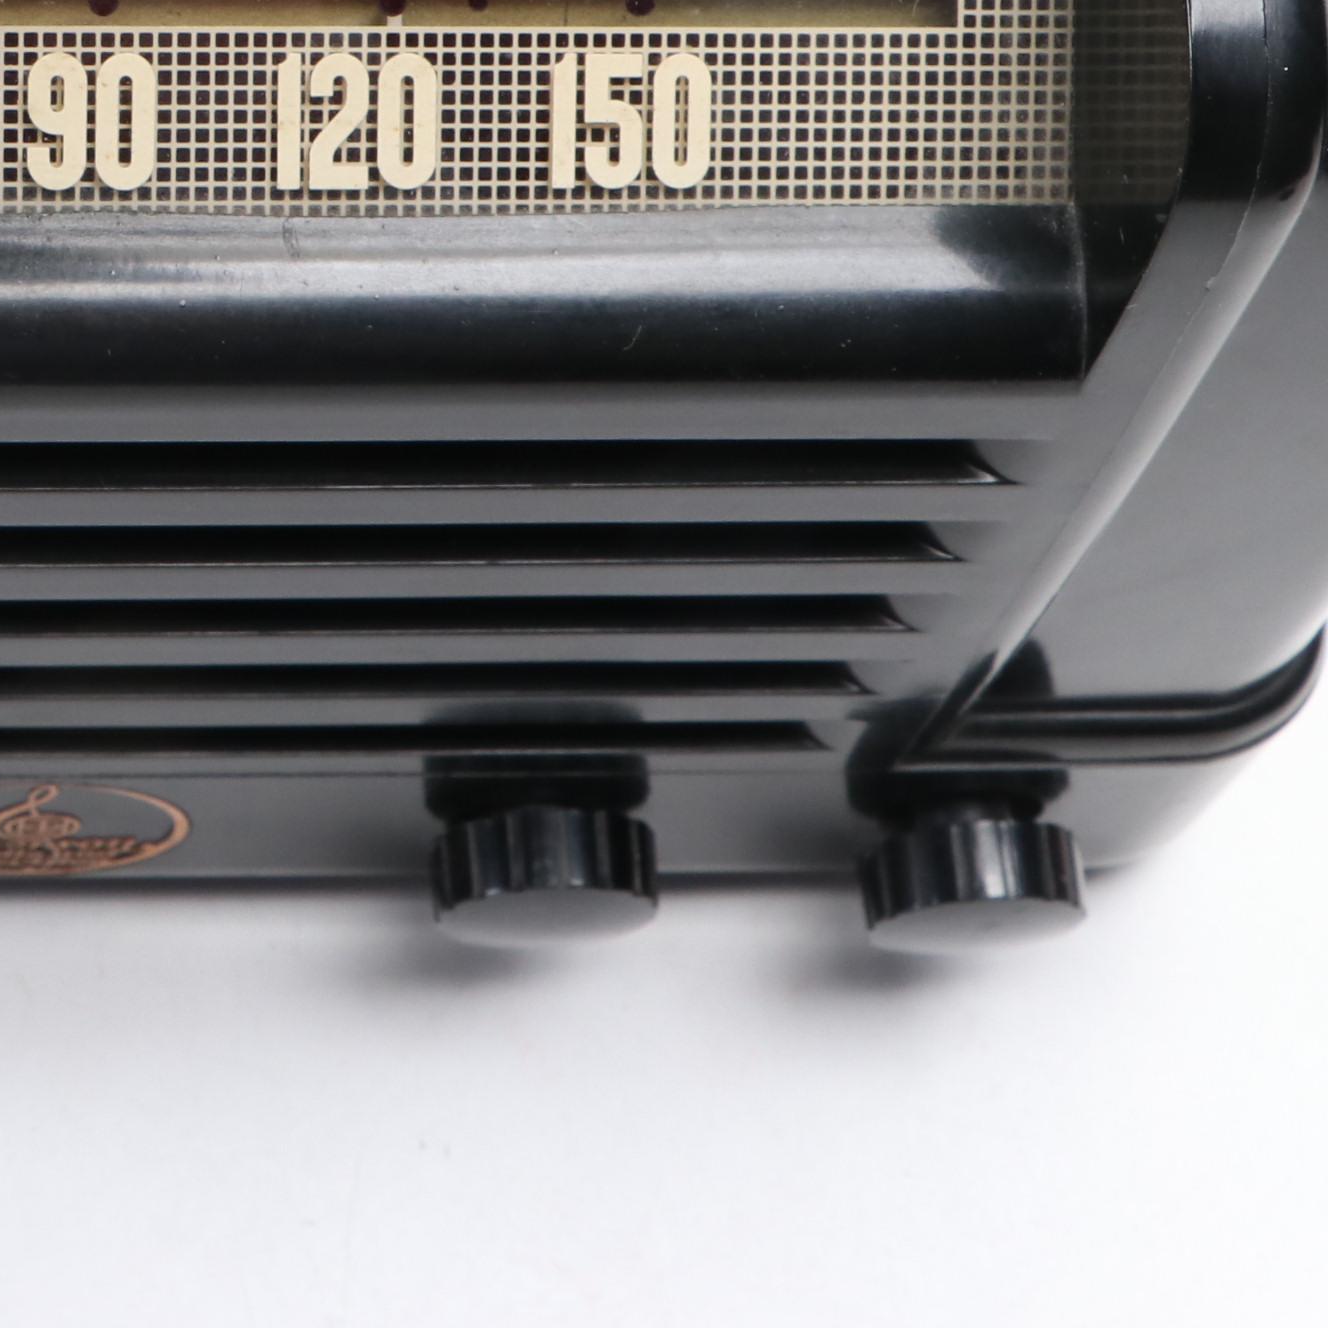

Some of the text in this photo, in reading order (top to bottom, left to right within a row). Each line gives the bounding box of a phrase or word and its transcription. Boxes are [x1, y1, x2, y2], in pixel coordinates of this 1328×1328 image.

[27, 53, 156, 191] 90
[276, 52, 438, 191] 120
[552, 52, 713, 191] 150
